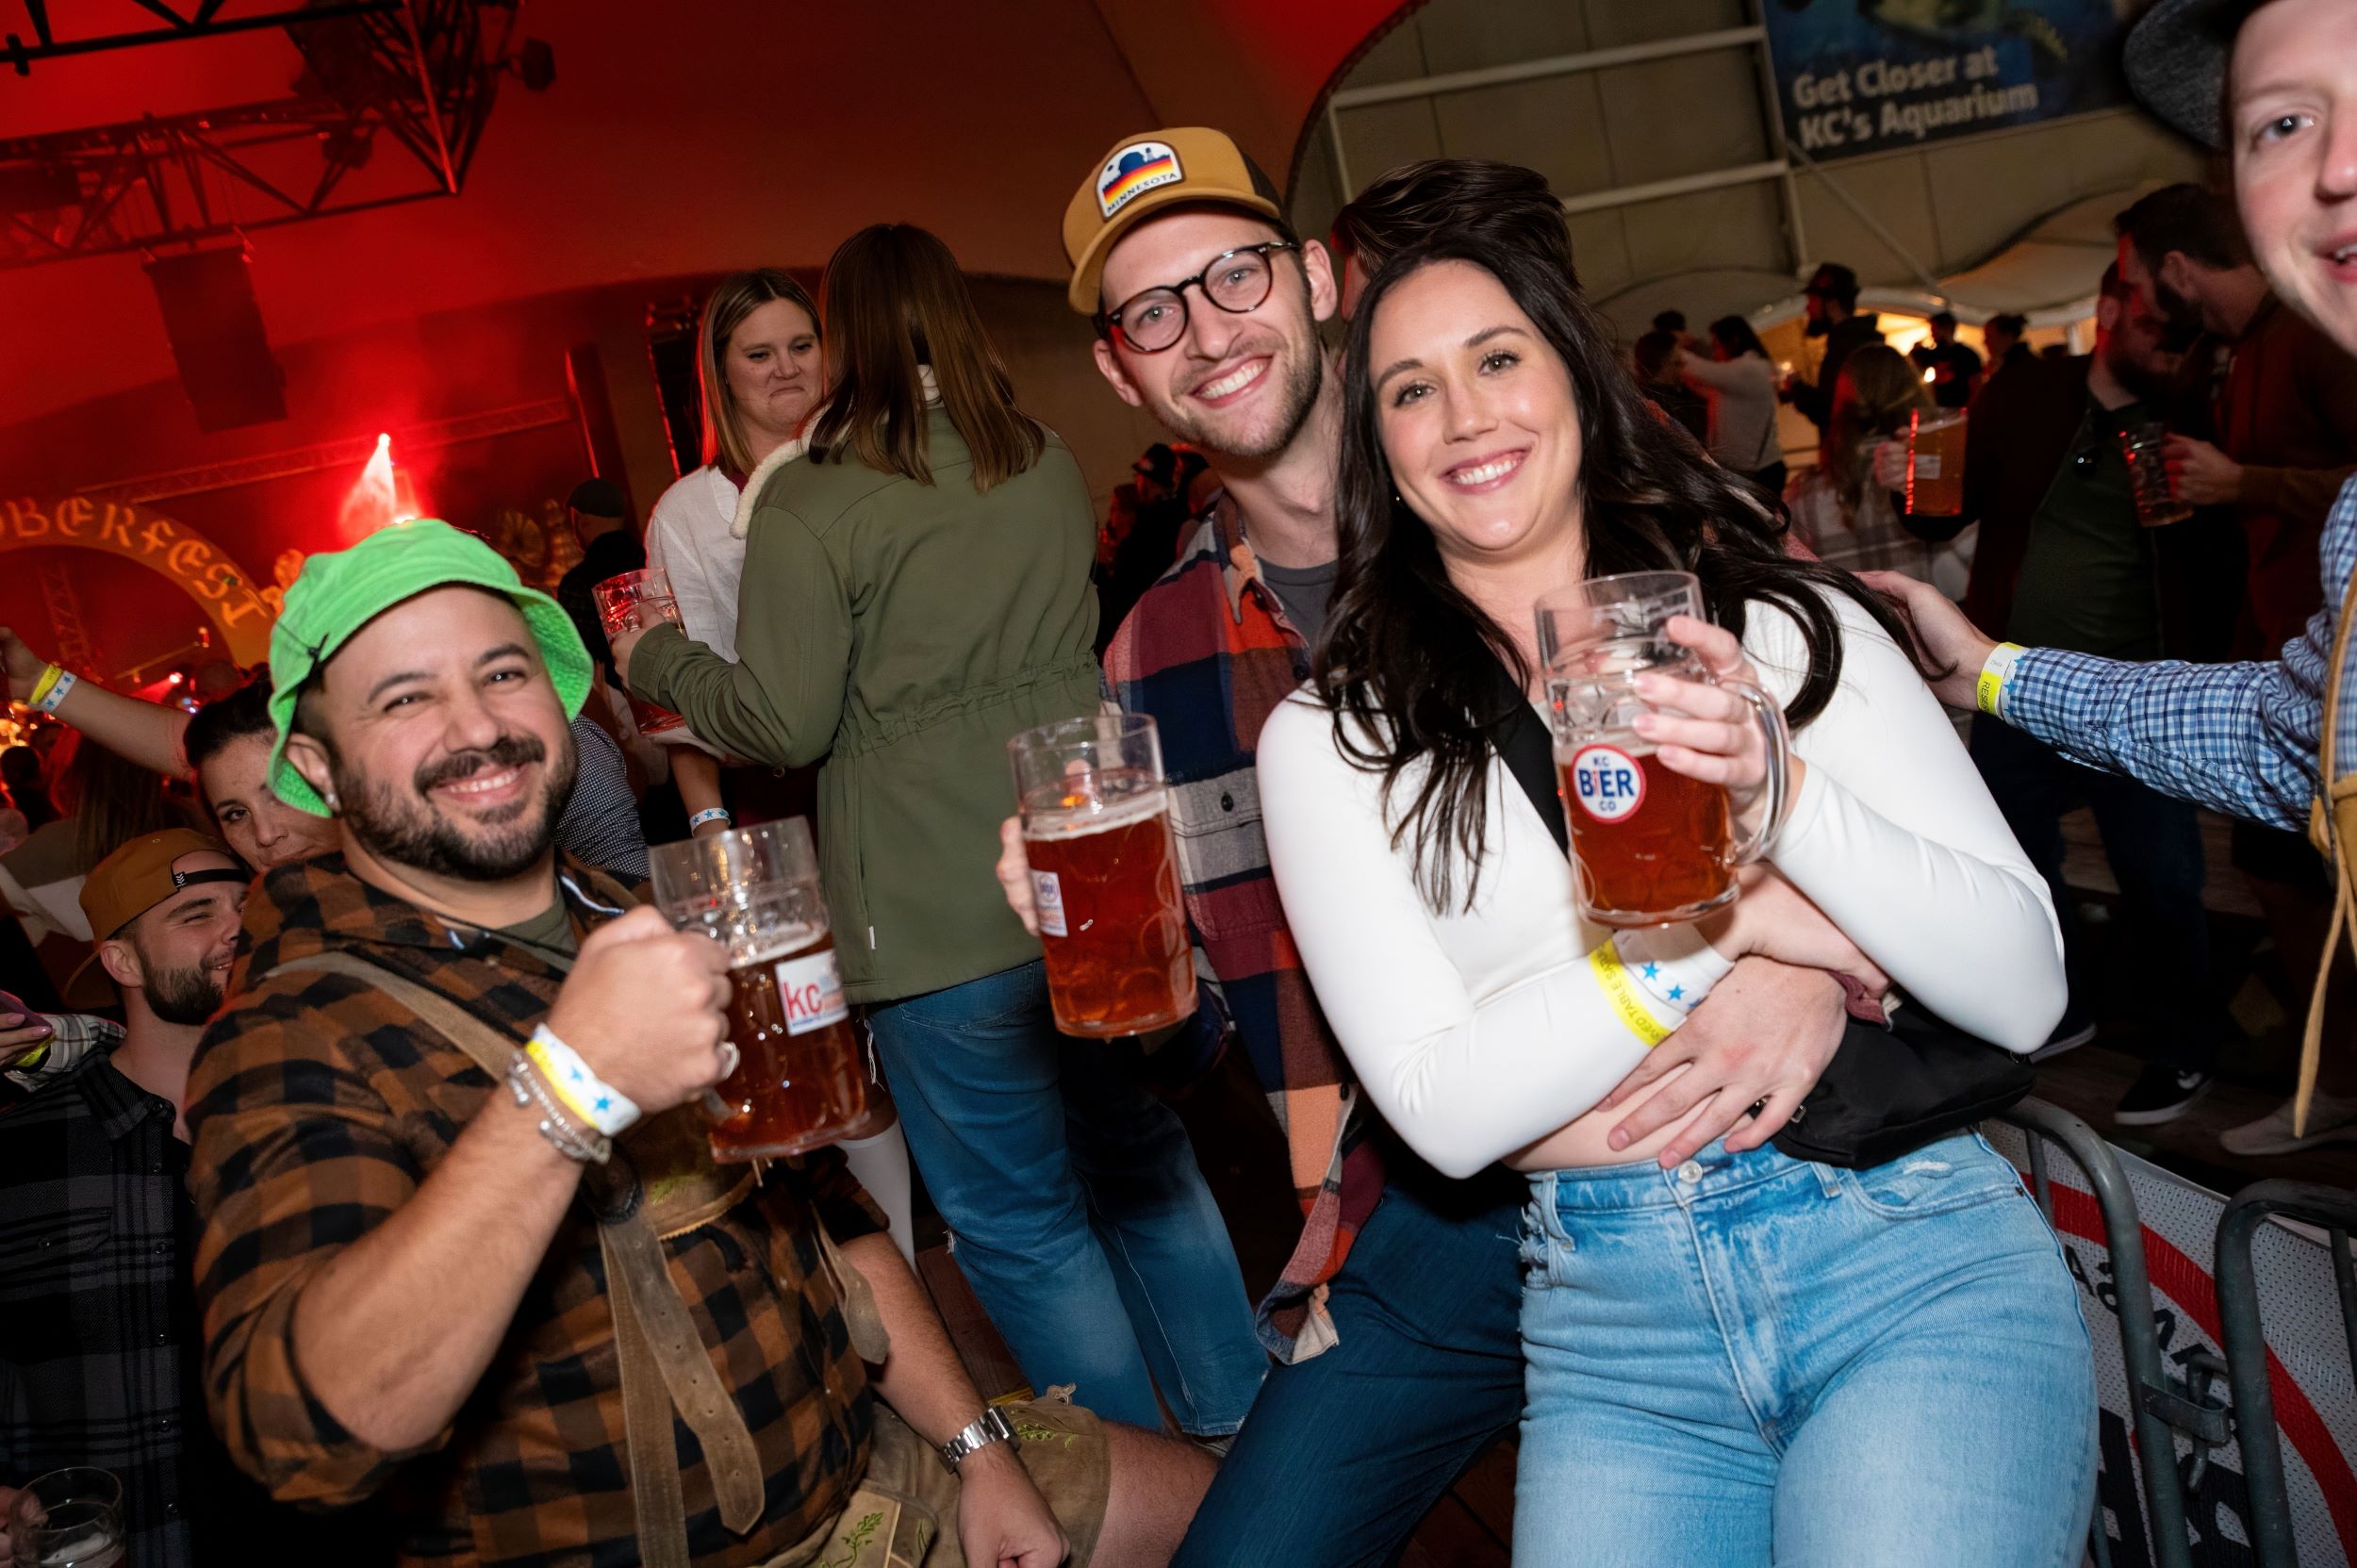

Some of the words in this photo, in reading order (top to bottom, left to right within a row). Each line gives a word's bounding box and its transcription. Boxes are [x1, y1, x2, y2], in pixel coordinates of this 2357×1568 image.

[1792, 71, 1853, 109] Get
[1856, 55, 1958, 97] Closer
[1964, 44, 2000, 78] at
[1798, 107, 1874, 150] KC's
[1879, 83, 2040, 140] Aquarium
[1107, 173, 1178, 212] MINNESOTA
[0, 496, 270, 628] BERFEST
[1593, 756, 1610, 767] KC
[1599, 801, 1616, 812] CO
[1611, 982, 1639, 1019] TABLE
